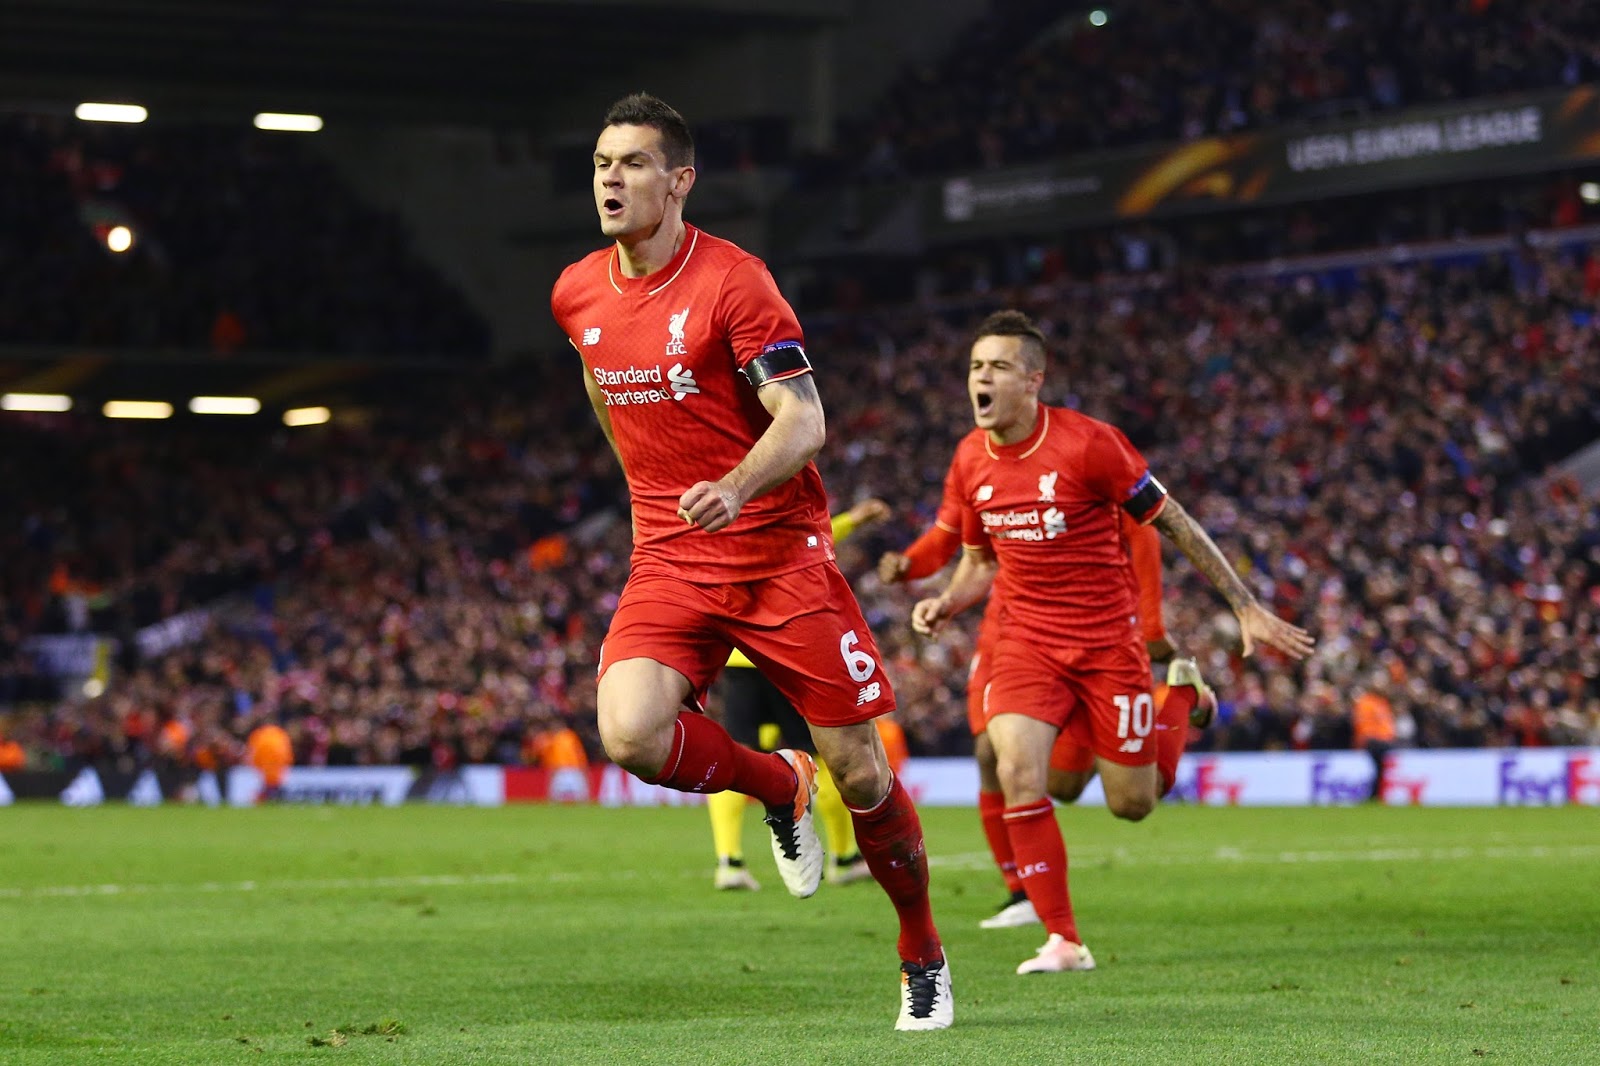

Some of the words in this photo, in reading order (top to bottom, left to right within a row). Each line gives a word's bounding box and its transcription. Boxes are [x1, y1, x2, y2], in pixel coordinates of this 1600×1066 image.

[593, 364, 662, 386] Standard
[980, 508, 1040, 527] Standard
[840, 629, 876, 682] 6
[1112, 692, 1153, 739] 10
